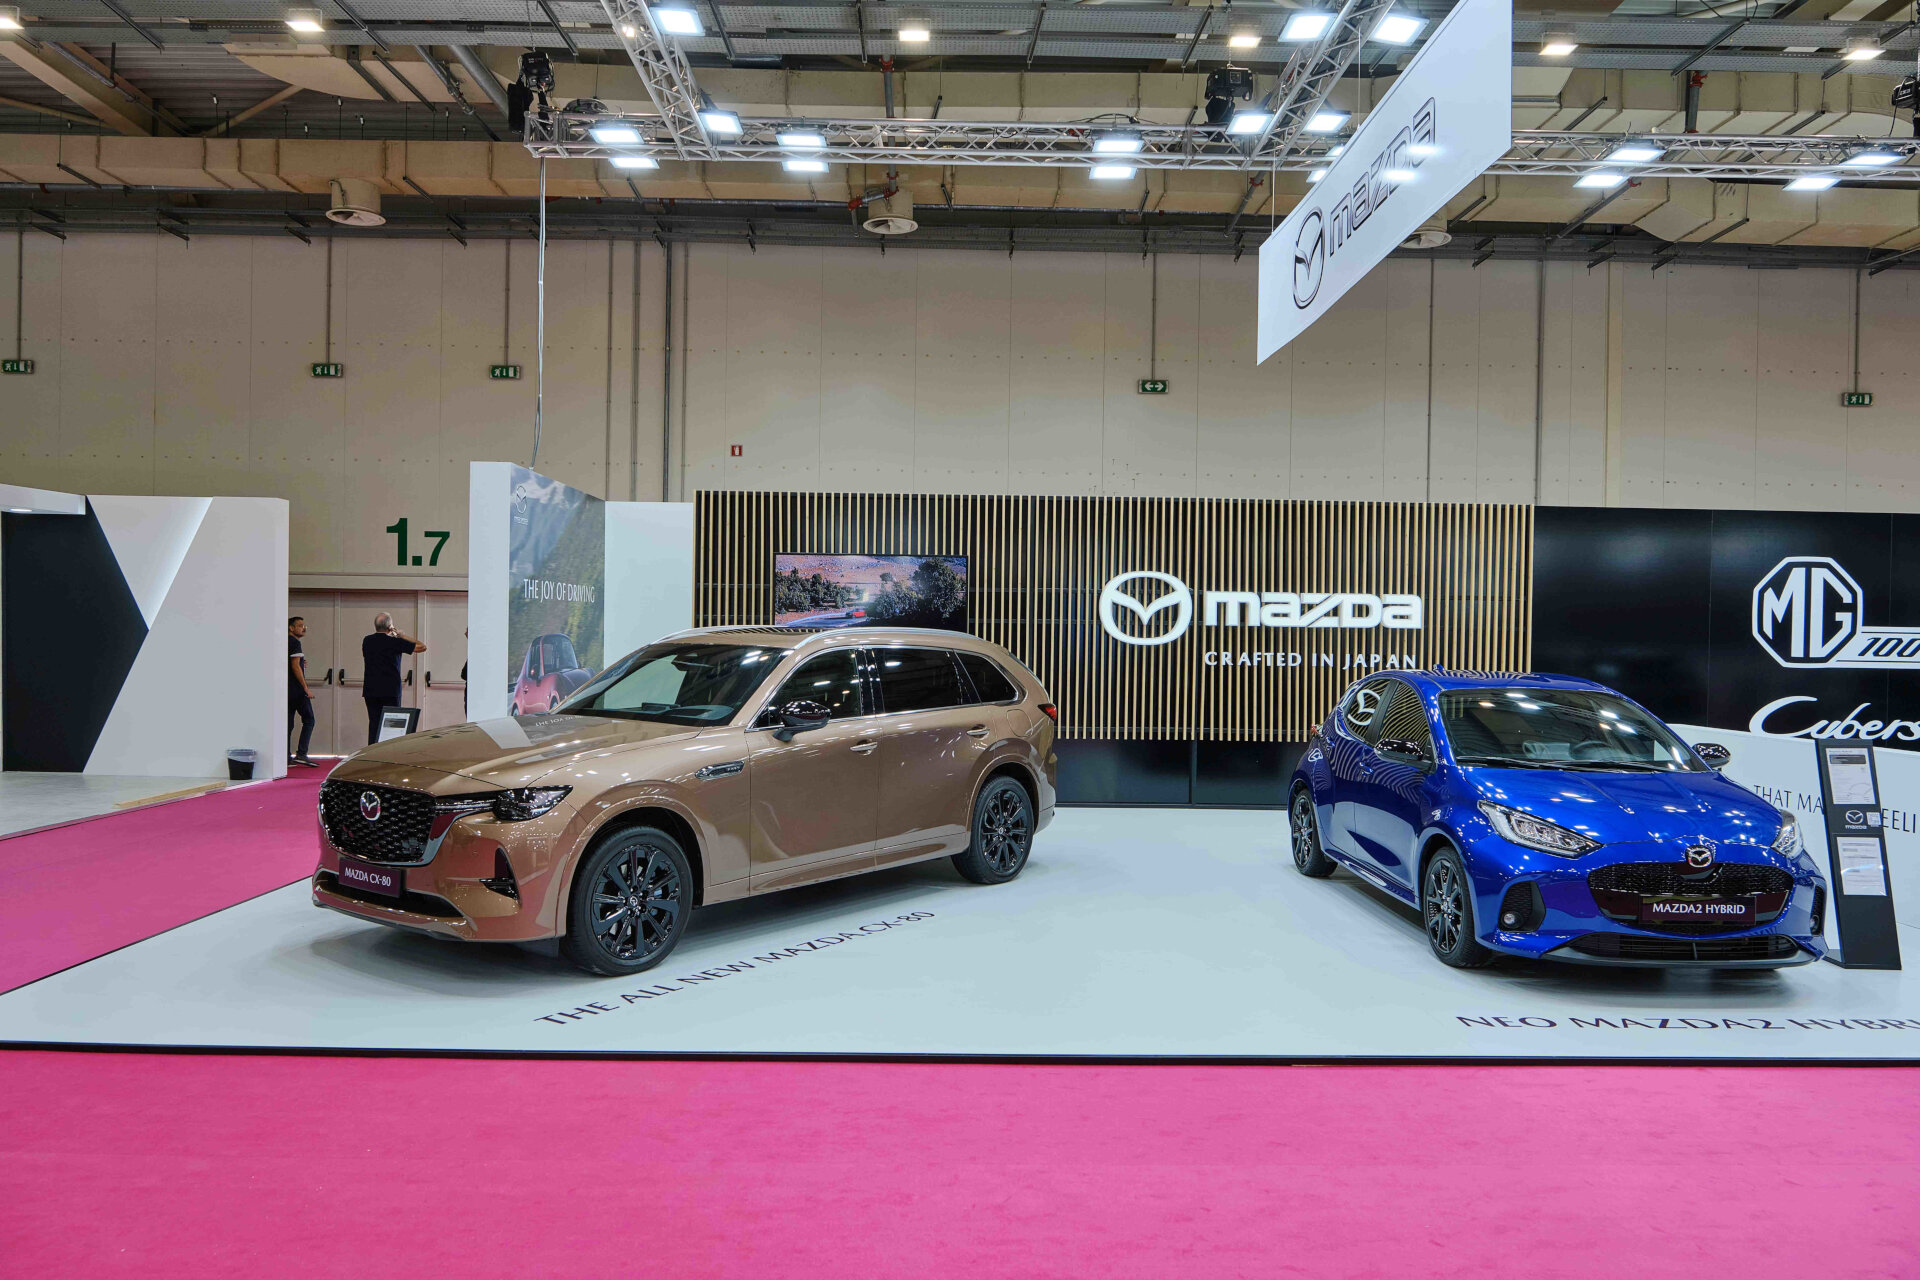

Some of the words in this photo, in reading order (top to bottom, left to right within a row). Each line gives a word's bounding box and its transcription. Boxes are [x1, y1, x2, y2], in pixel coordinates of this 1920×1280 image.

[386, 517, 450, 567] 1.7
[523, 578, 539, 600] THE
[540, 580, 555, 603] JOY
[556, 582, 567, 601] OF
[567, 583, 595, 604] DRIVING
[1204, 590, 1423, 630] mazda
[1762, 567, 1853, 658] MG
[1203, 651, 1302, 667] CRAFTED
[1311, 652, 1335, 668] IN
[1342, 653, 1417, 670] JAPAN
[1753, 784, 1793, 810] THAT
[344, 866, 369, 883] MAZDA
[369, 873, 392, 887] CX-80
[1652, 903, 1703, 914] MAZDA2
[1705, 904, 1746, 915] HYBRID
[533, 1001, 620, 1025] THE
[620, 984, 684, 1004] ALL
[675, 960, 756, 985] NEW
[1455, 1016, 1558, 1028] NEO
[1568, 1017, 1786, 1030] MAZDA2
